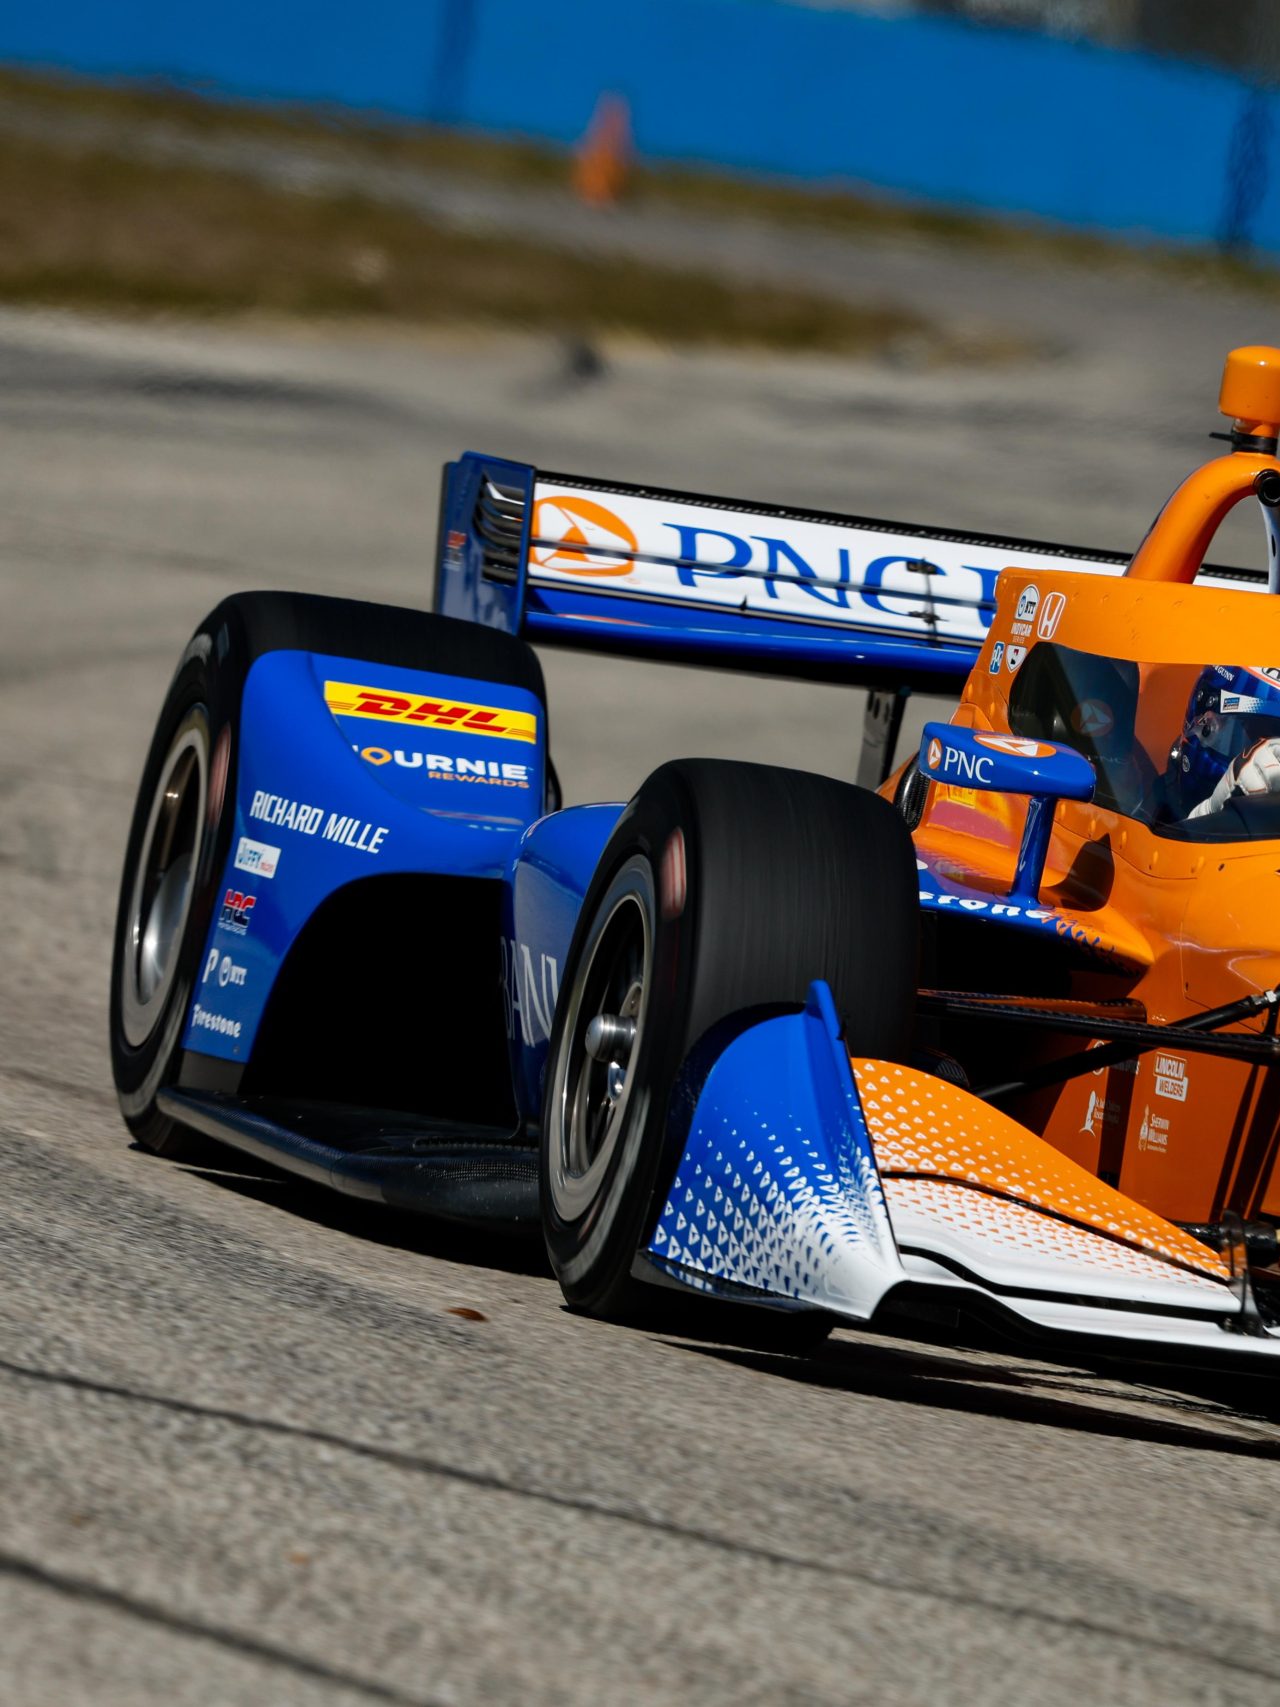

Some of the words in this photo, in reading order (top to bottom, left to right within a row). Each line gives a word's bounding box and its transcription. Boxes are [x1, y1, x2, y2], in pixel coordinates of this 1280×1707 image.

[662, 521, 944, 616] PNC
[354, 692, 508, 733] DHL
[353, 745, 529, 780] OURNIE
[428, 771, 530, 789] REWARDS
[943, 746, 995, 783] PNC
[250, 790, 324, 835] RICHARD
[322, 813, 389, 854] MILLE
[191, 1003, 241, 1038] Firestone
[1155, 1056, 1185, 1079] LINCOLN
[1159, 1079, 1184, 1097] WELDERS
